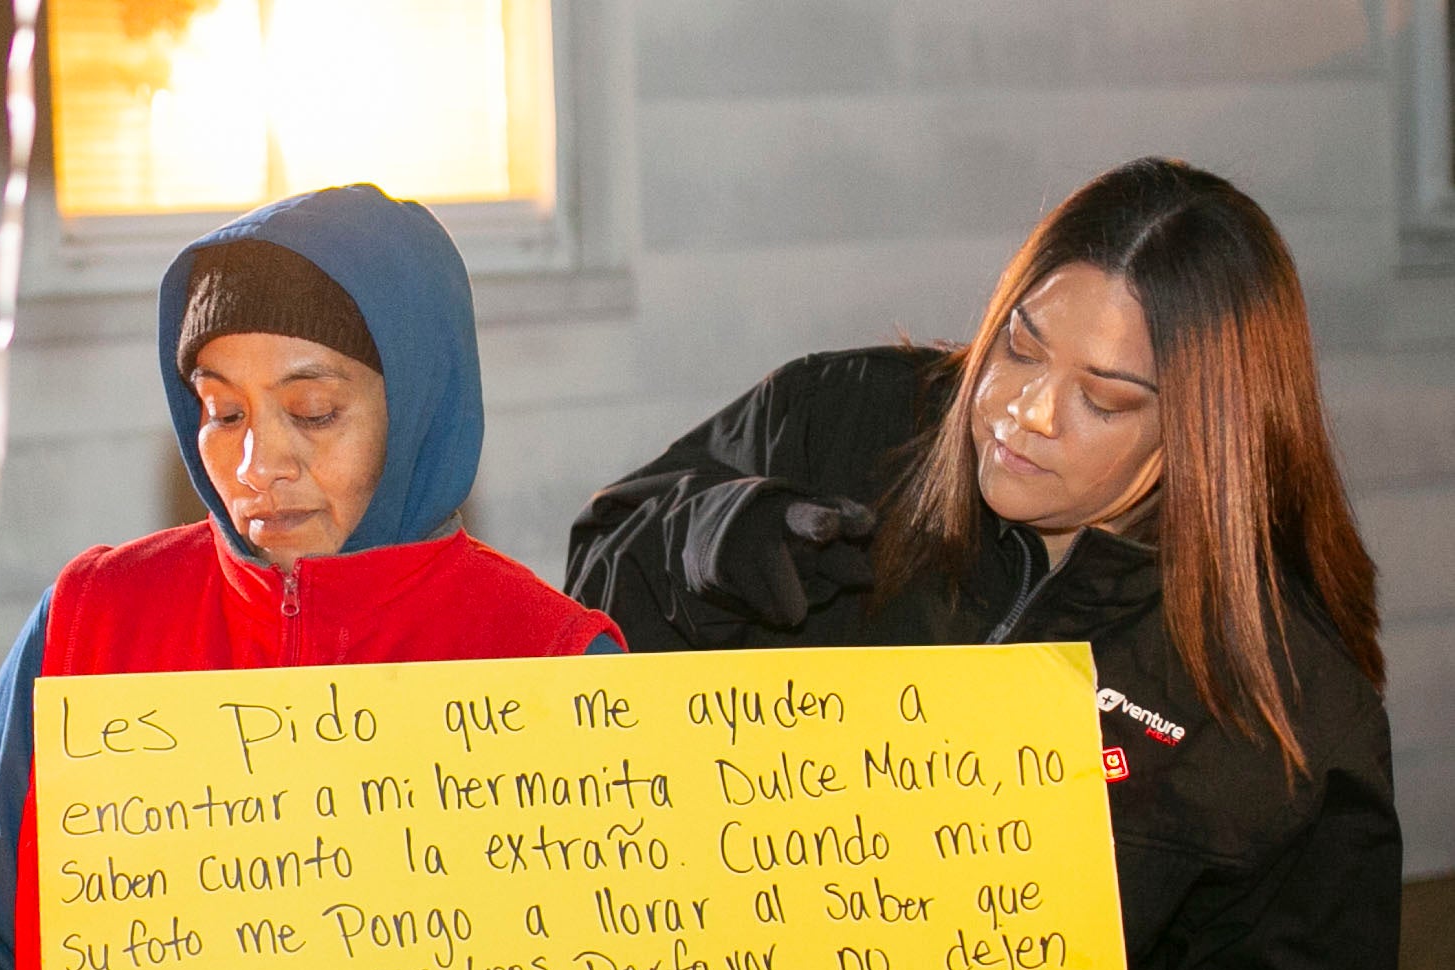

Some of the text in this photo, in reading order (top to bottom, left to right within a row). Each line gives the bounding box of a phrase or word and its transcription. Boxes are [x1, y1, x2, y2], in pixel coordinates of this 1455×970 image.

[63, 696, 178, 759] Les
[445, 695, 525, 753] que
[573, 688, 639, 729] me
[688, 678, 845, 746] ayuden
[899, 683, 928, 724] a
[1121, 697, 1186, 741] venture
[62, 785, 288, 836] encontrar
[316, 786, 338, 818] a
[361, 776, 415, 816] mi
[434, 758, 674, 811] hermanita
[714, 751, 847, 806] Dulce
[1017, 745, 1064, 786] no
[405, 826, 449, 876] la
[934, 819, 1032, 859] miro
[122, 916, 203, 968] foto
[235, 918, 307, 955] me
[525, 904, 550, 939] a
[594, 886, 710, 936] llorar
[754, 883, 786, 924] al
[977, 881, 1043, 931] que
